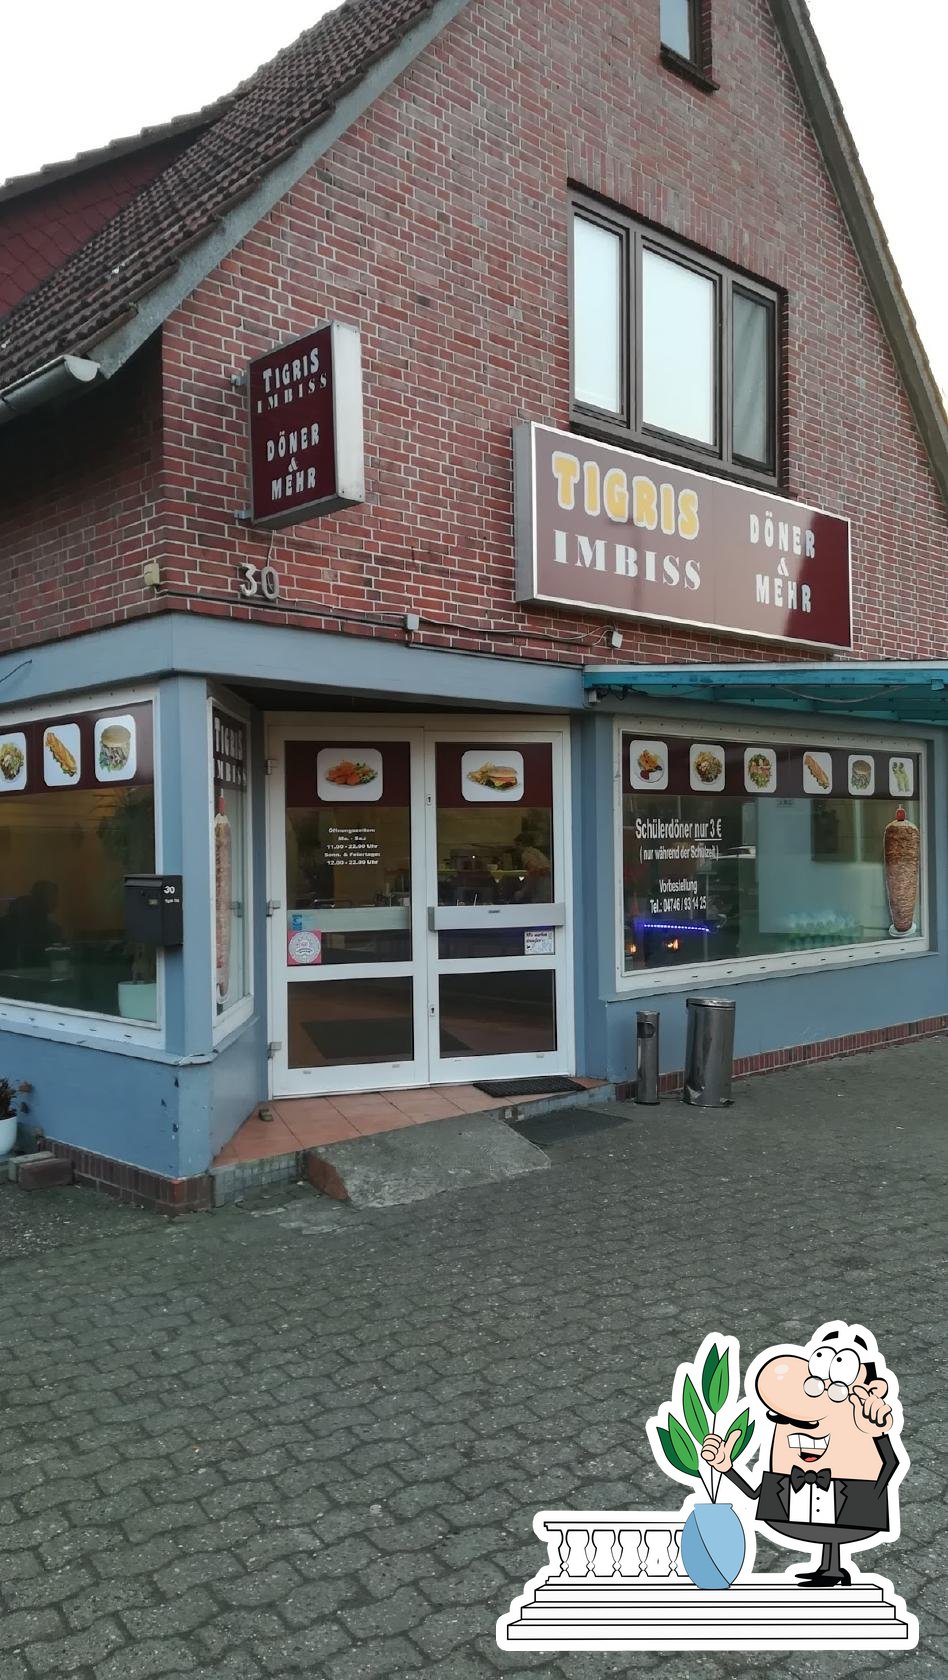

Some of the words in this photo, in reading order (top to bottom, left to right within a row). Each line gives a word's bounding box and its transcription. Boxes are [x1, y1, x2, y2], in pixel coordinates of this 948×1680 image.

[263, 348, 320, 393] TIGRIS
[257, 372, 327, 413] IMBISS
[267, 423, 320, 461] DÖNER
[288, 457, 298, 472] &
[271, 467, 316, 500] MEHR
[552, 451, 700, 540] TIGRIS
[749, 511, 815, 559] DÖNER
[553, 529, 701, 591] IMBISS
[776, 557, 789, 577] &
[239, 562, 280, 600] 30
[755, 574, 812, 613] MEHR
[635, 818, 693, 839] Schülerdöner
[694, 822, 709, 838] nur
[709, 818, 715, 838] 3
[716, 818, 722, 838] €
[655, 845, 680, 860] während
[163, 885, 176, 894] 30
[659, 878, 698, 894] Vorbestellung
[649, 899, 663, 913] Tel.:
[663, 898, 680, 912] 04746
